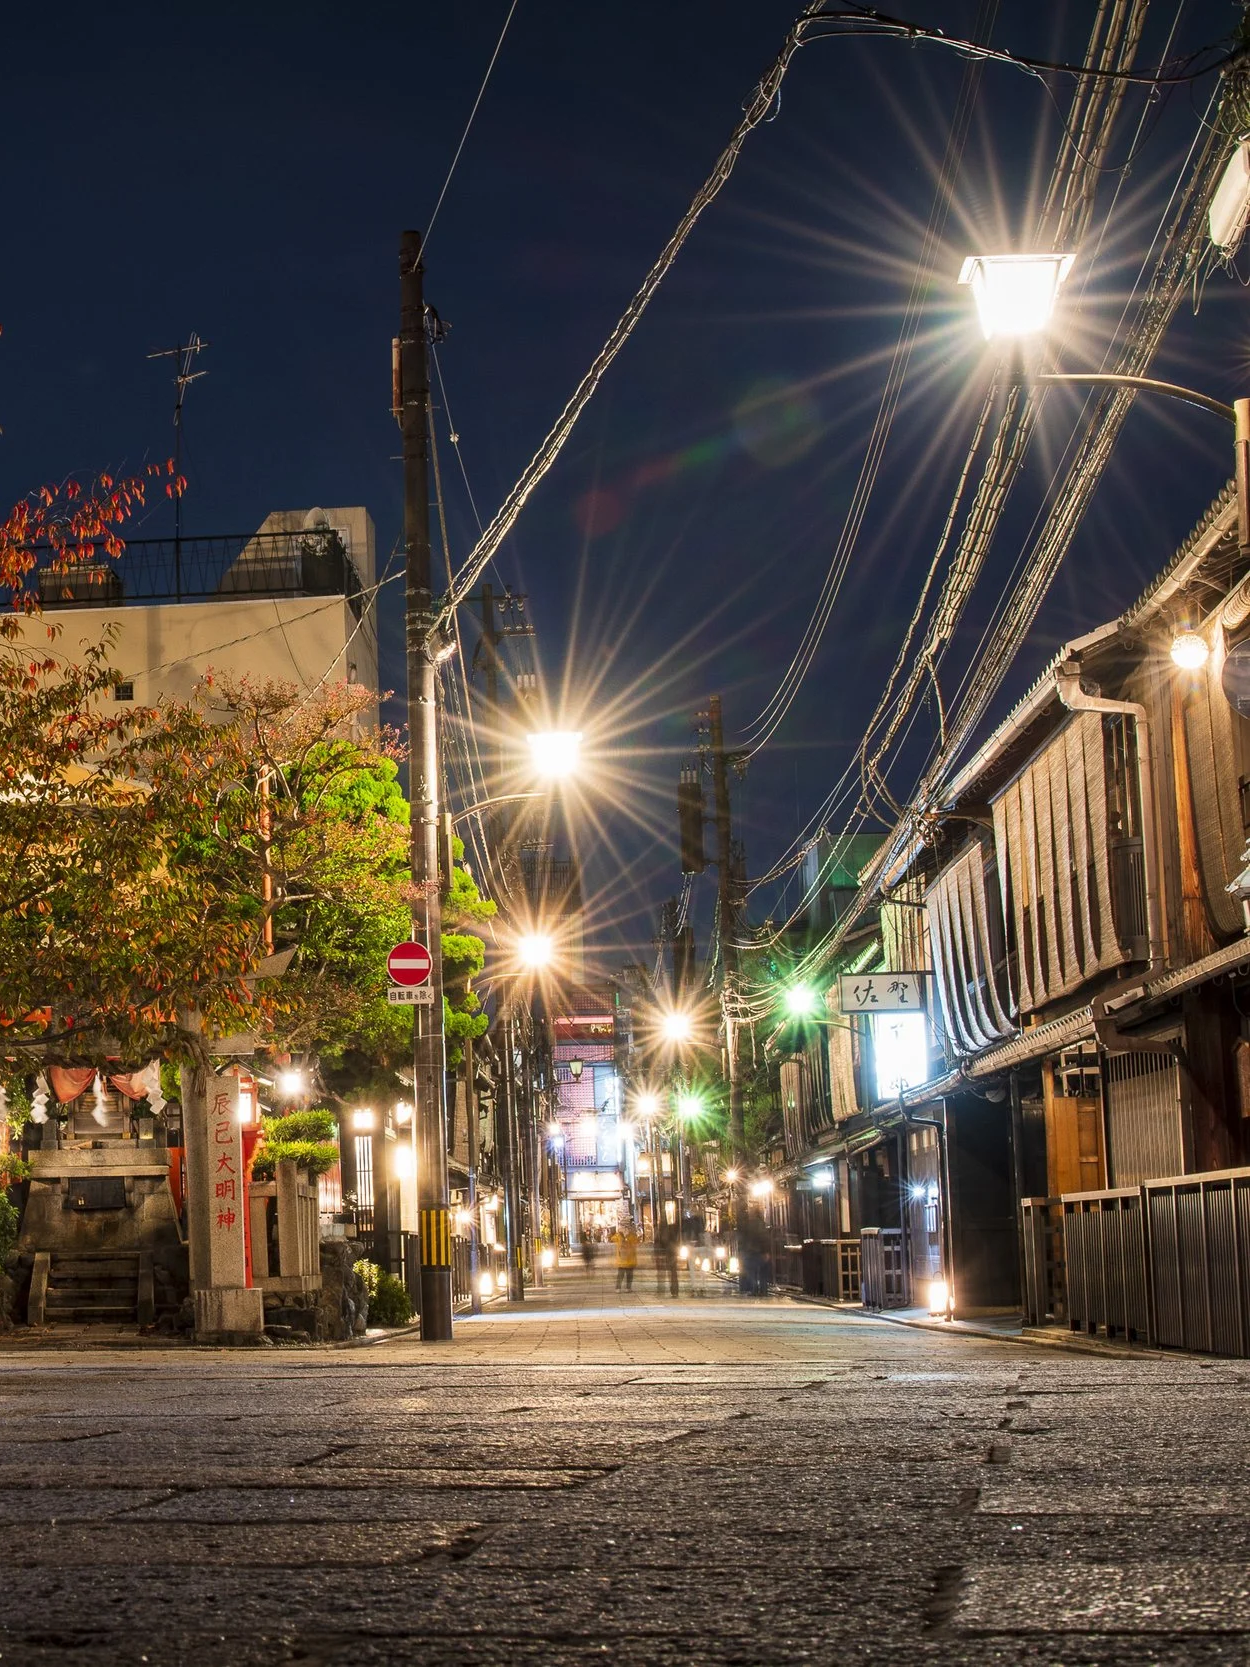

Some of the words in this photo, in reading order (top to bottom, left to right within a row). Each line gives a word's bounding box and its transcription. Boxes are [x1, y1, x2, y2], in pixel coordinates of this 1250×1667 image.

[389, 990, 433, 1001] 自転車を除く
